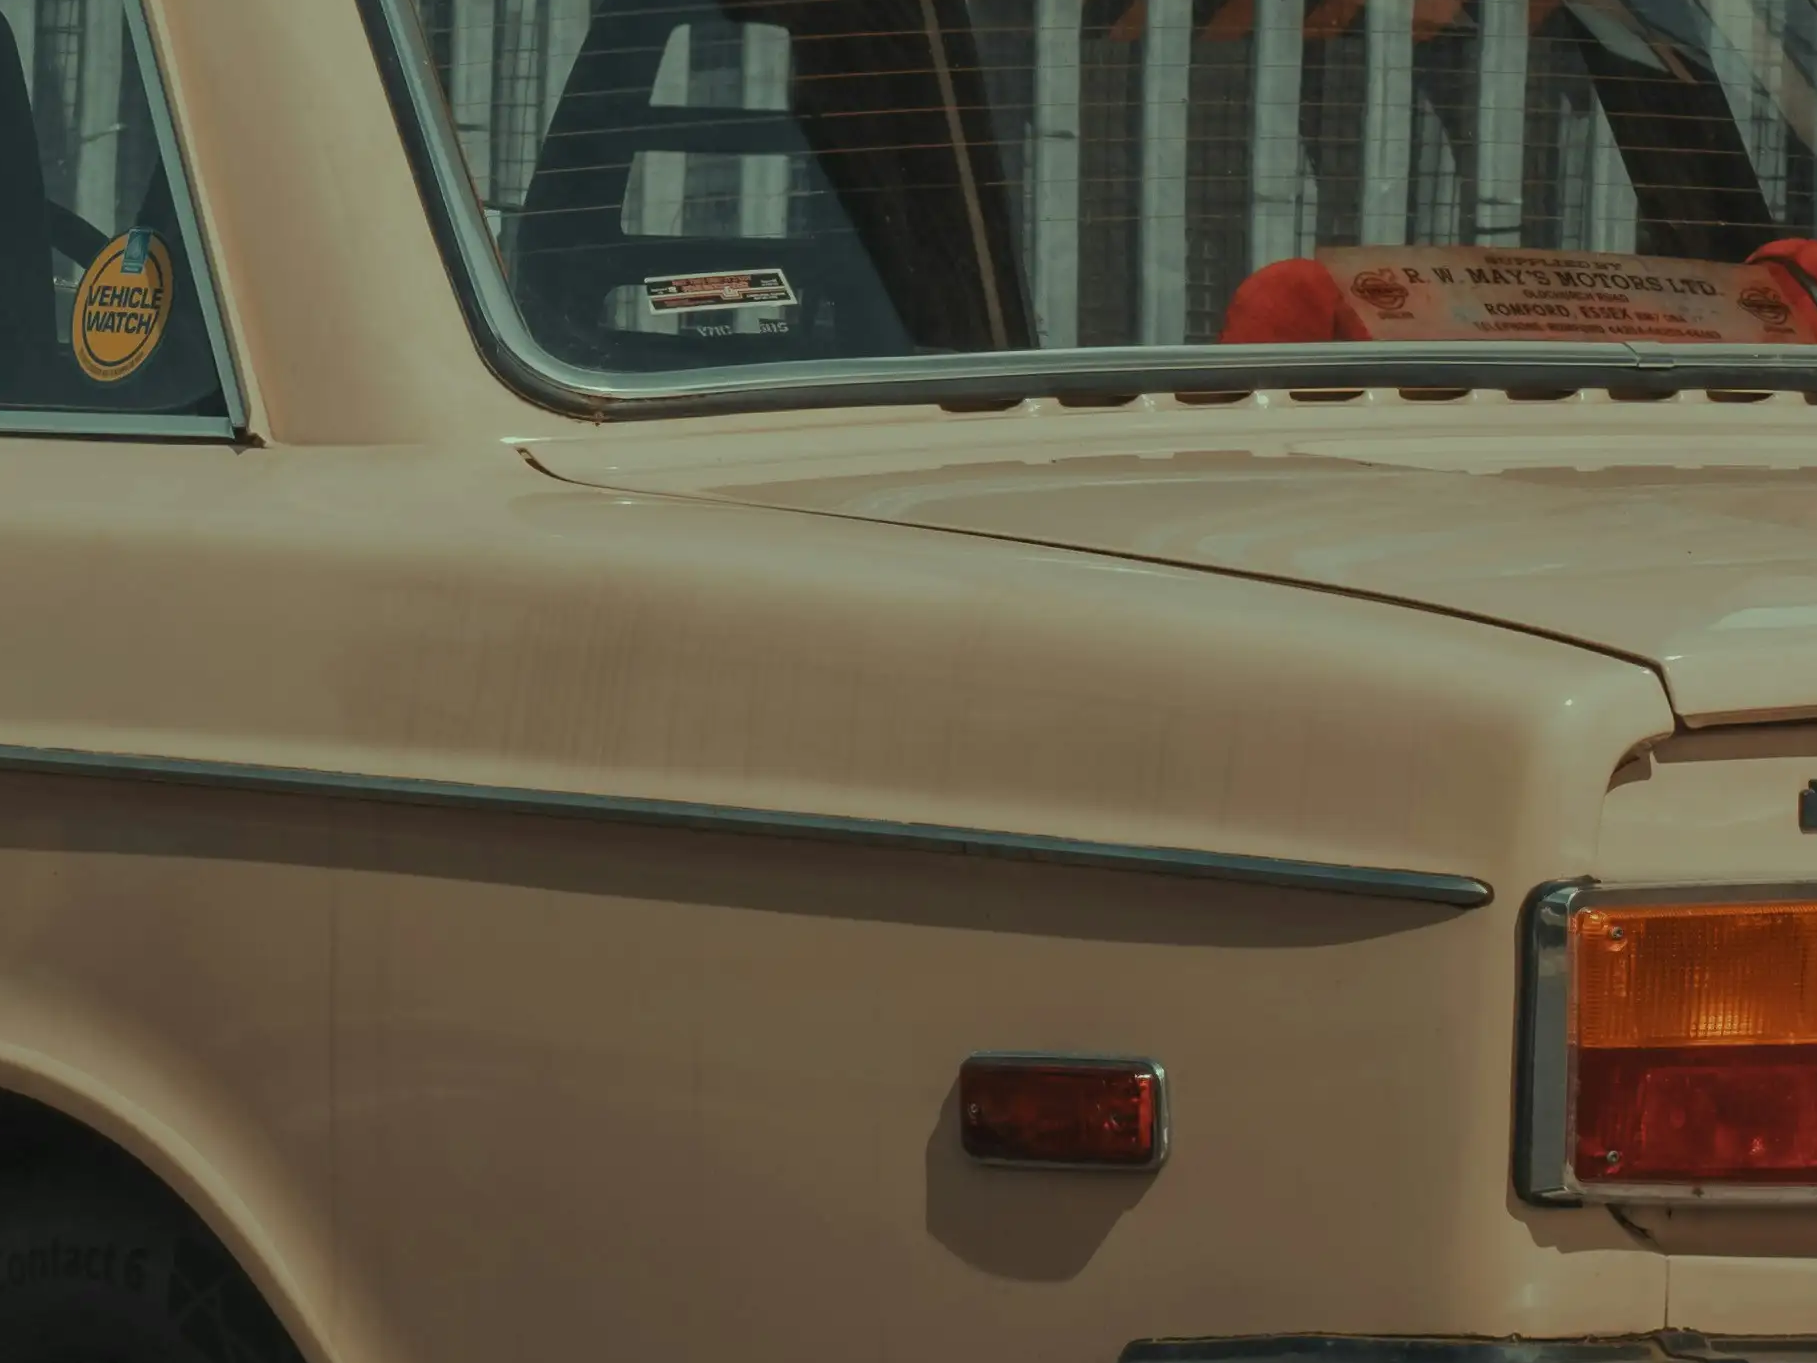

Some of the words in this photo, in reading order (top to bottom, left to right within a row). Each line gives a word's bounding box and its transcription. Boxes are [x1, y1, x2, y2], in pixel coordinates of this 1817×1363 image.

[1465, 267, 1552, 287] MAY'S
[1554, 271, 1664, 292] MOTORS
[87, 286, 164, 309] VEHICLE
[87, 311, 154, 335] WATCH
[1578, 306, 1632, 320] ESSEX
